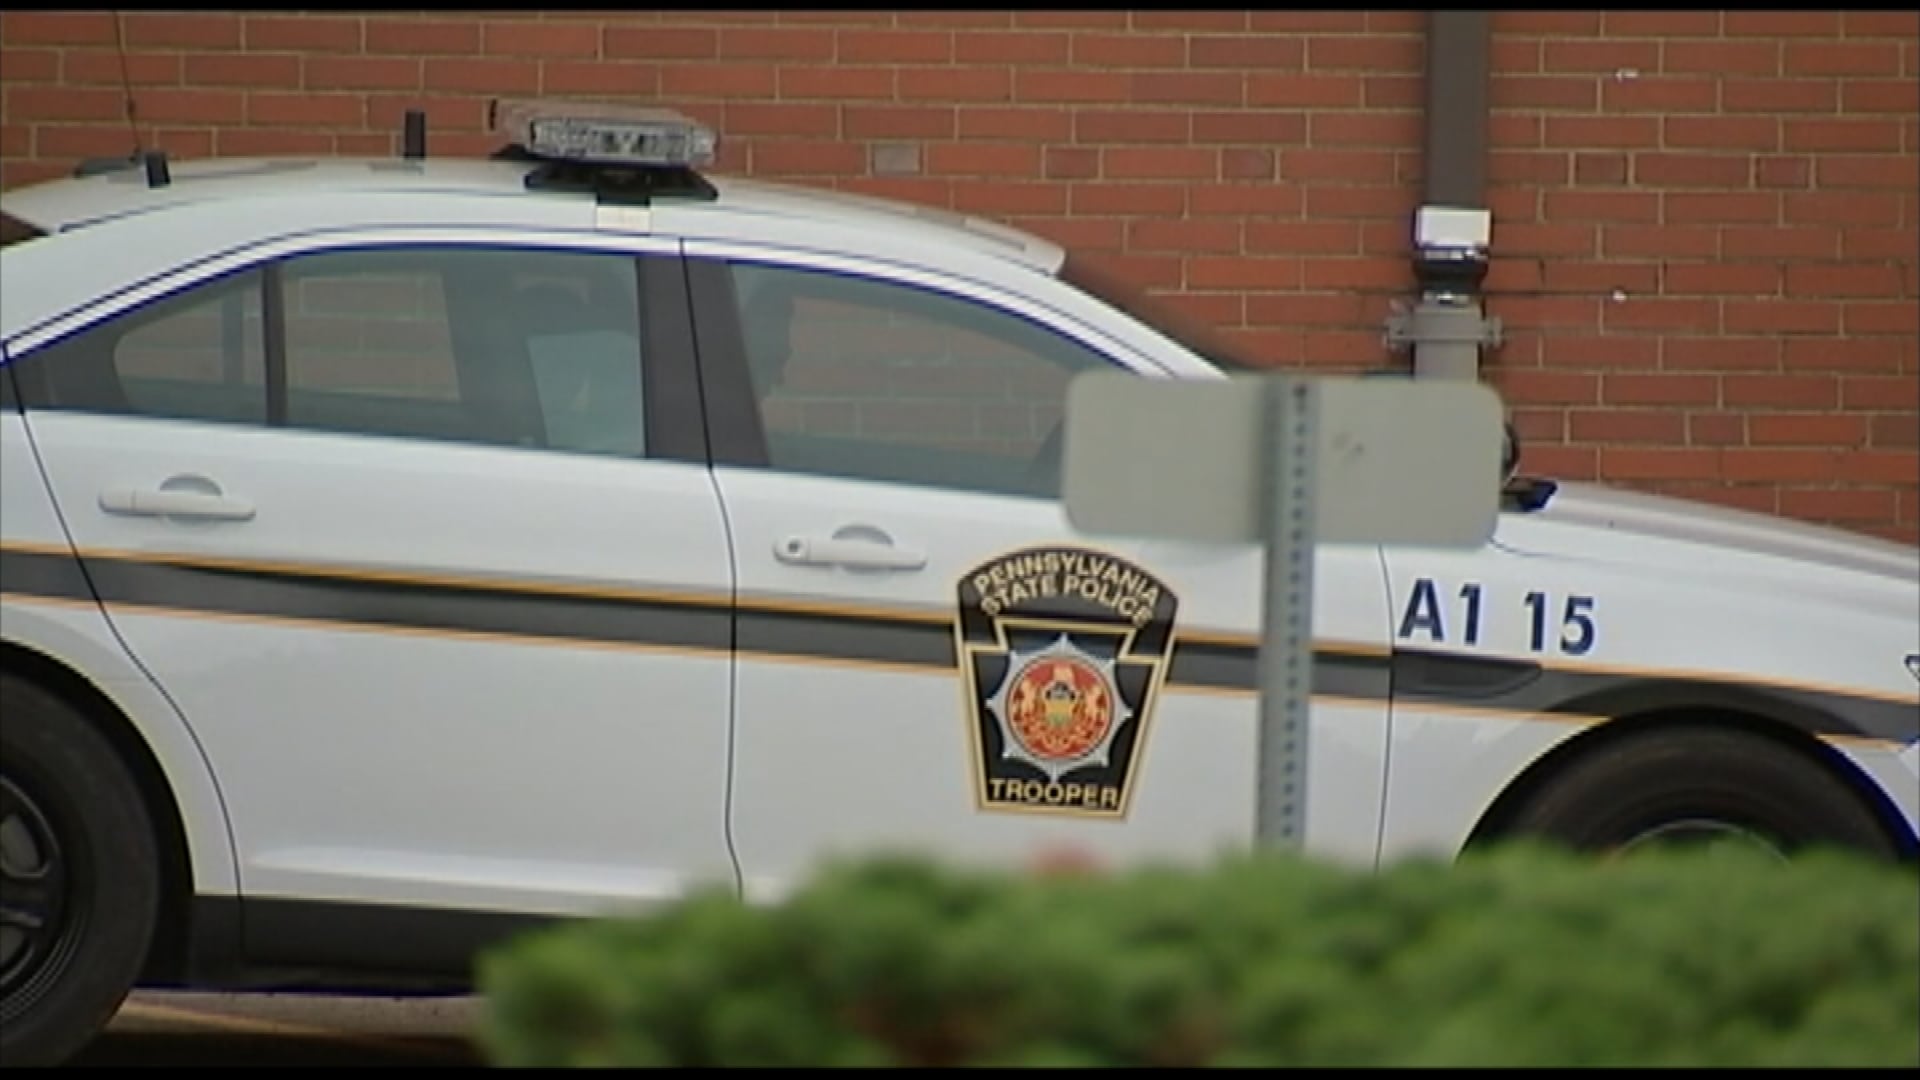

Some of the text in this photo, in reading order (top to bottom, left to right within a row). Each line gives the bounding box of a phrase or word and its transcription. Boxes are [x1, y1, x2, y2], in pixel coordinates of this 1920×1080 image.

[973, 552, 1159, 607] PENNSYLVANIA
[981, 574, 1153, 627] STATE POLICE
[1398, 578, 1594, 656] A1 15
[989, 778, 1119, 810] TROOPER
